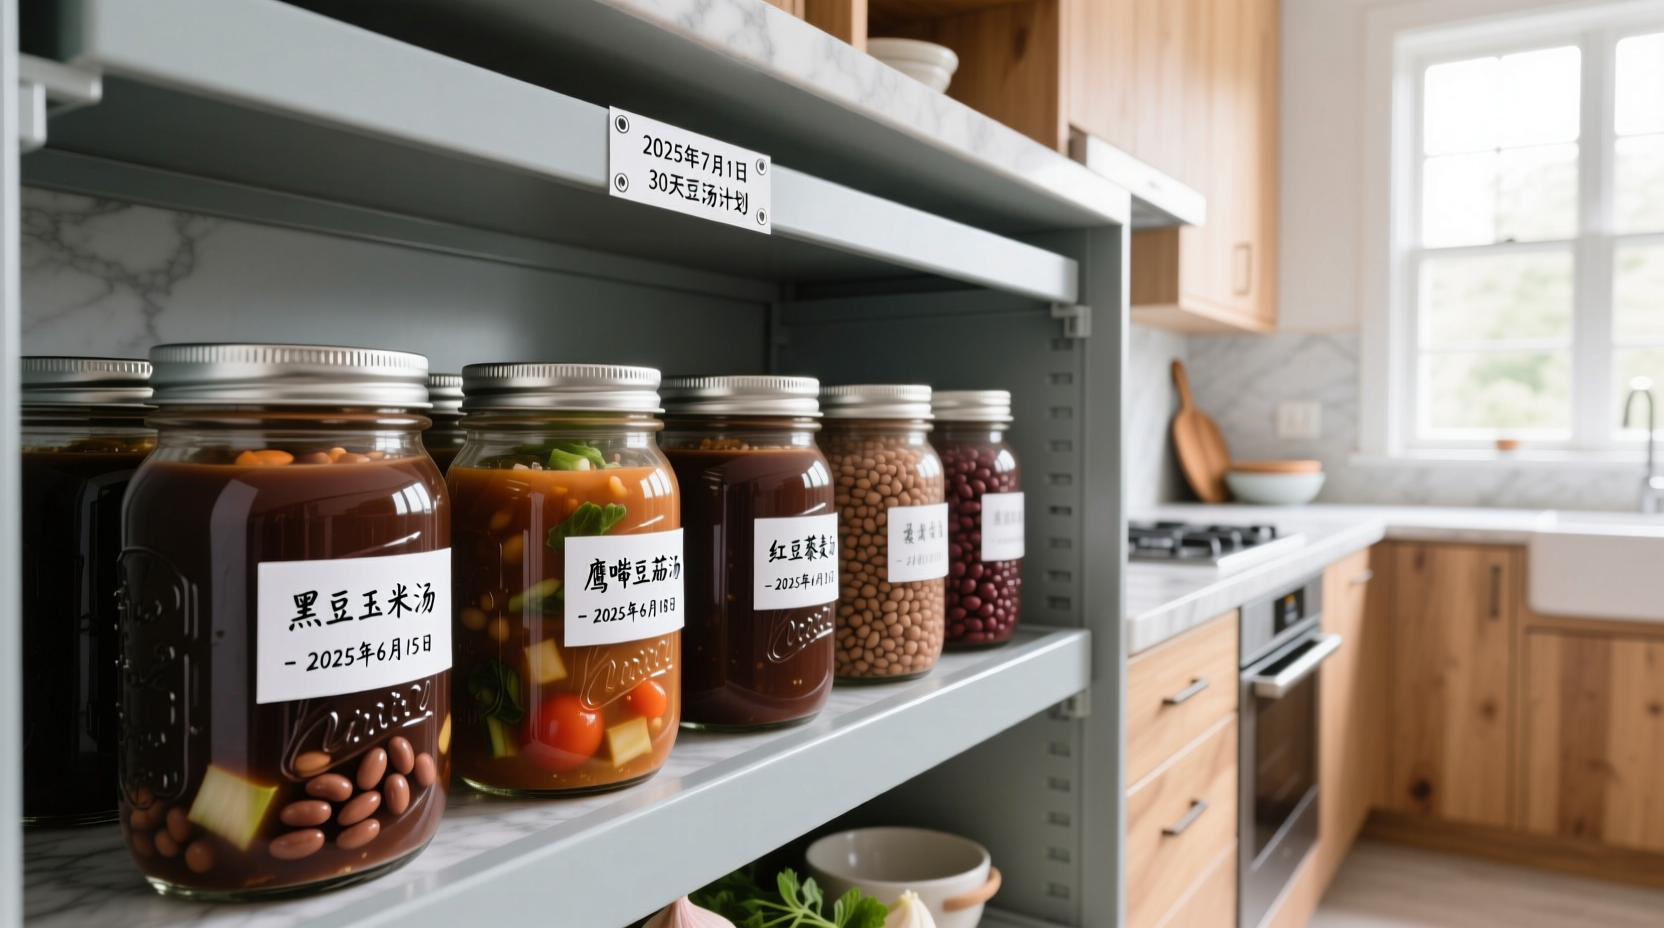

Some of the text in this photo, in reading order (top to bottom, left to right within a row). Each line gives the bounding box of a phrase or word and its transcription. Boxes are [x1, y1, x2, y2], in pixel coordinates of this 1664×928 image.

[642, 134, 747, 183] 2025年7月1日
[648, 168, 749, 216] 30天豆汤计划
[288, 582, 436, 632] 黑豆玉米汤
[305, 633, 432, 672] 2025年6月15日
